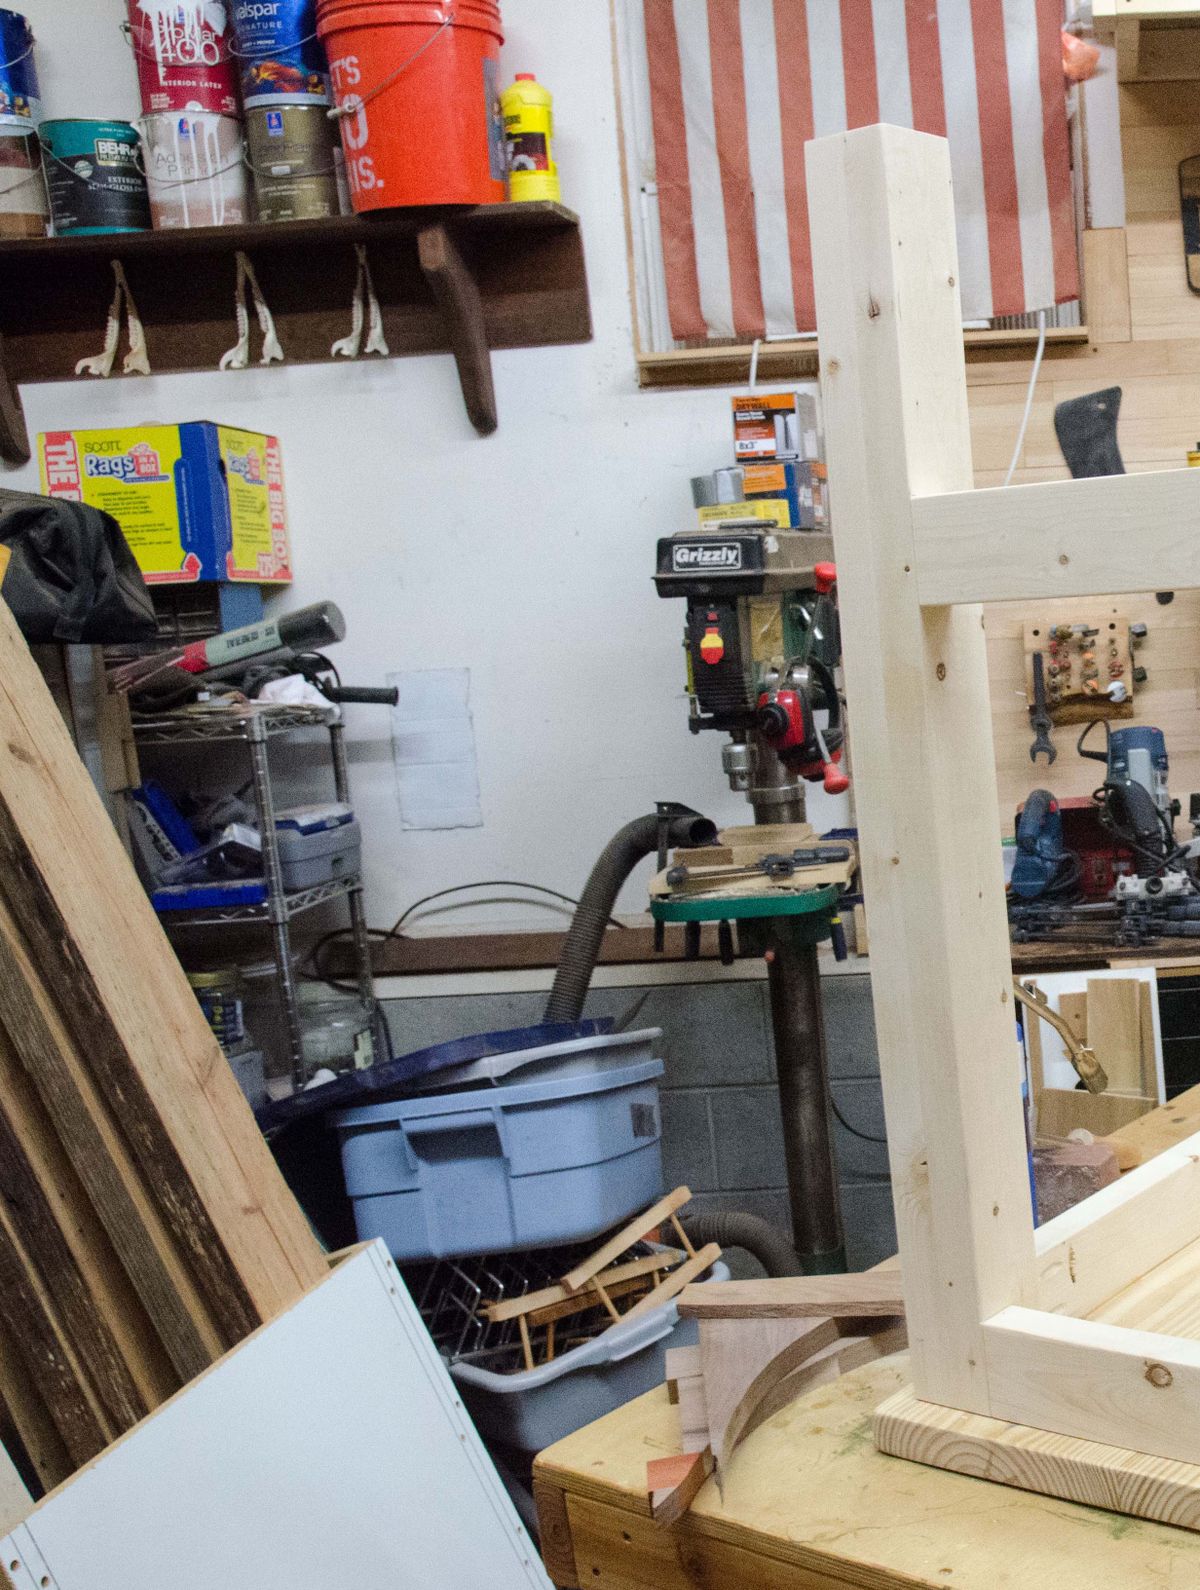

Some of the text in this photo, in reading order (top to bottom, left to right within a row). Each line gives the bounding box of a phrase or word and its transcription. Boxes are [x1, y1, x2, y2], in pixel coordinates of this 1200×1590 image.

[160, 39, 220, 66] 400
[98, 141, 130, 156] BEHR
[84, 440, 121, 453] SCOTT
[46, 440, 80, 485] THE
[85, 453, 136, 480] Rags
[675, 547, 738, 565] Grizzly
